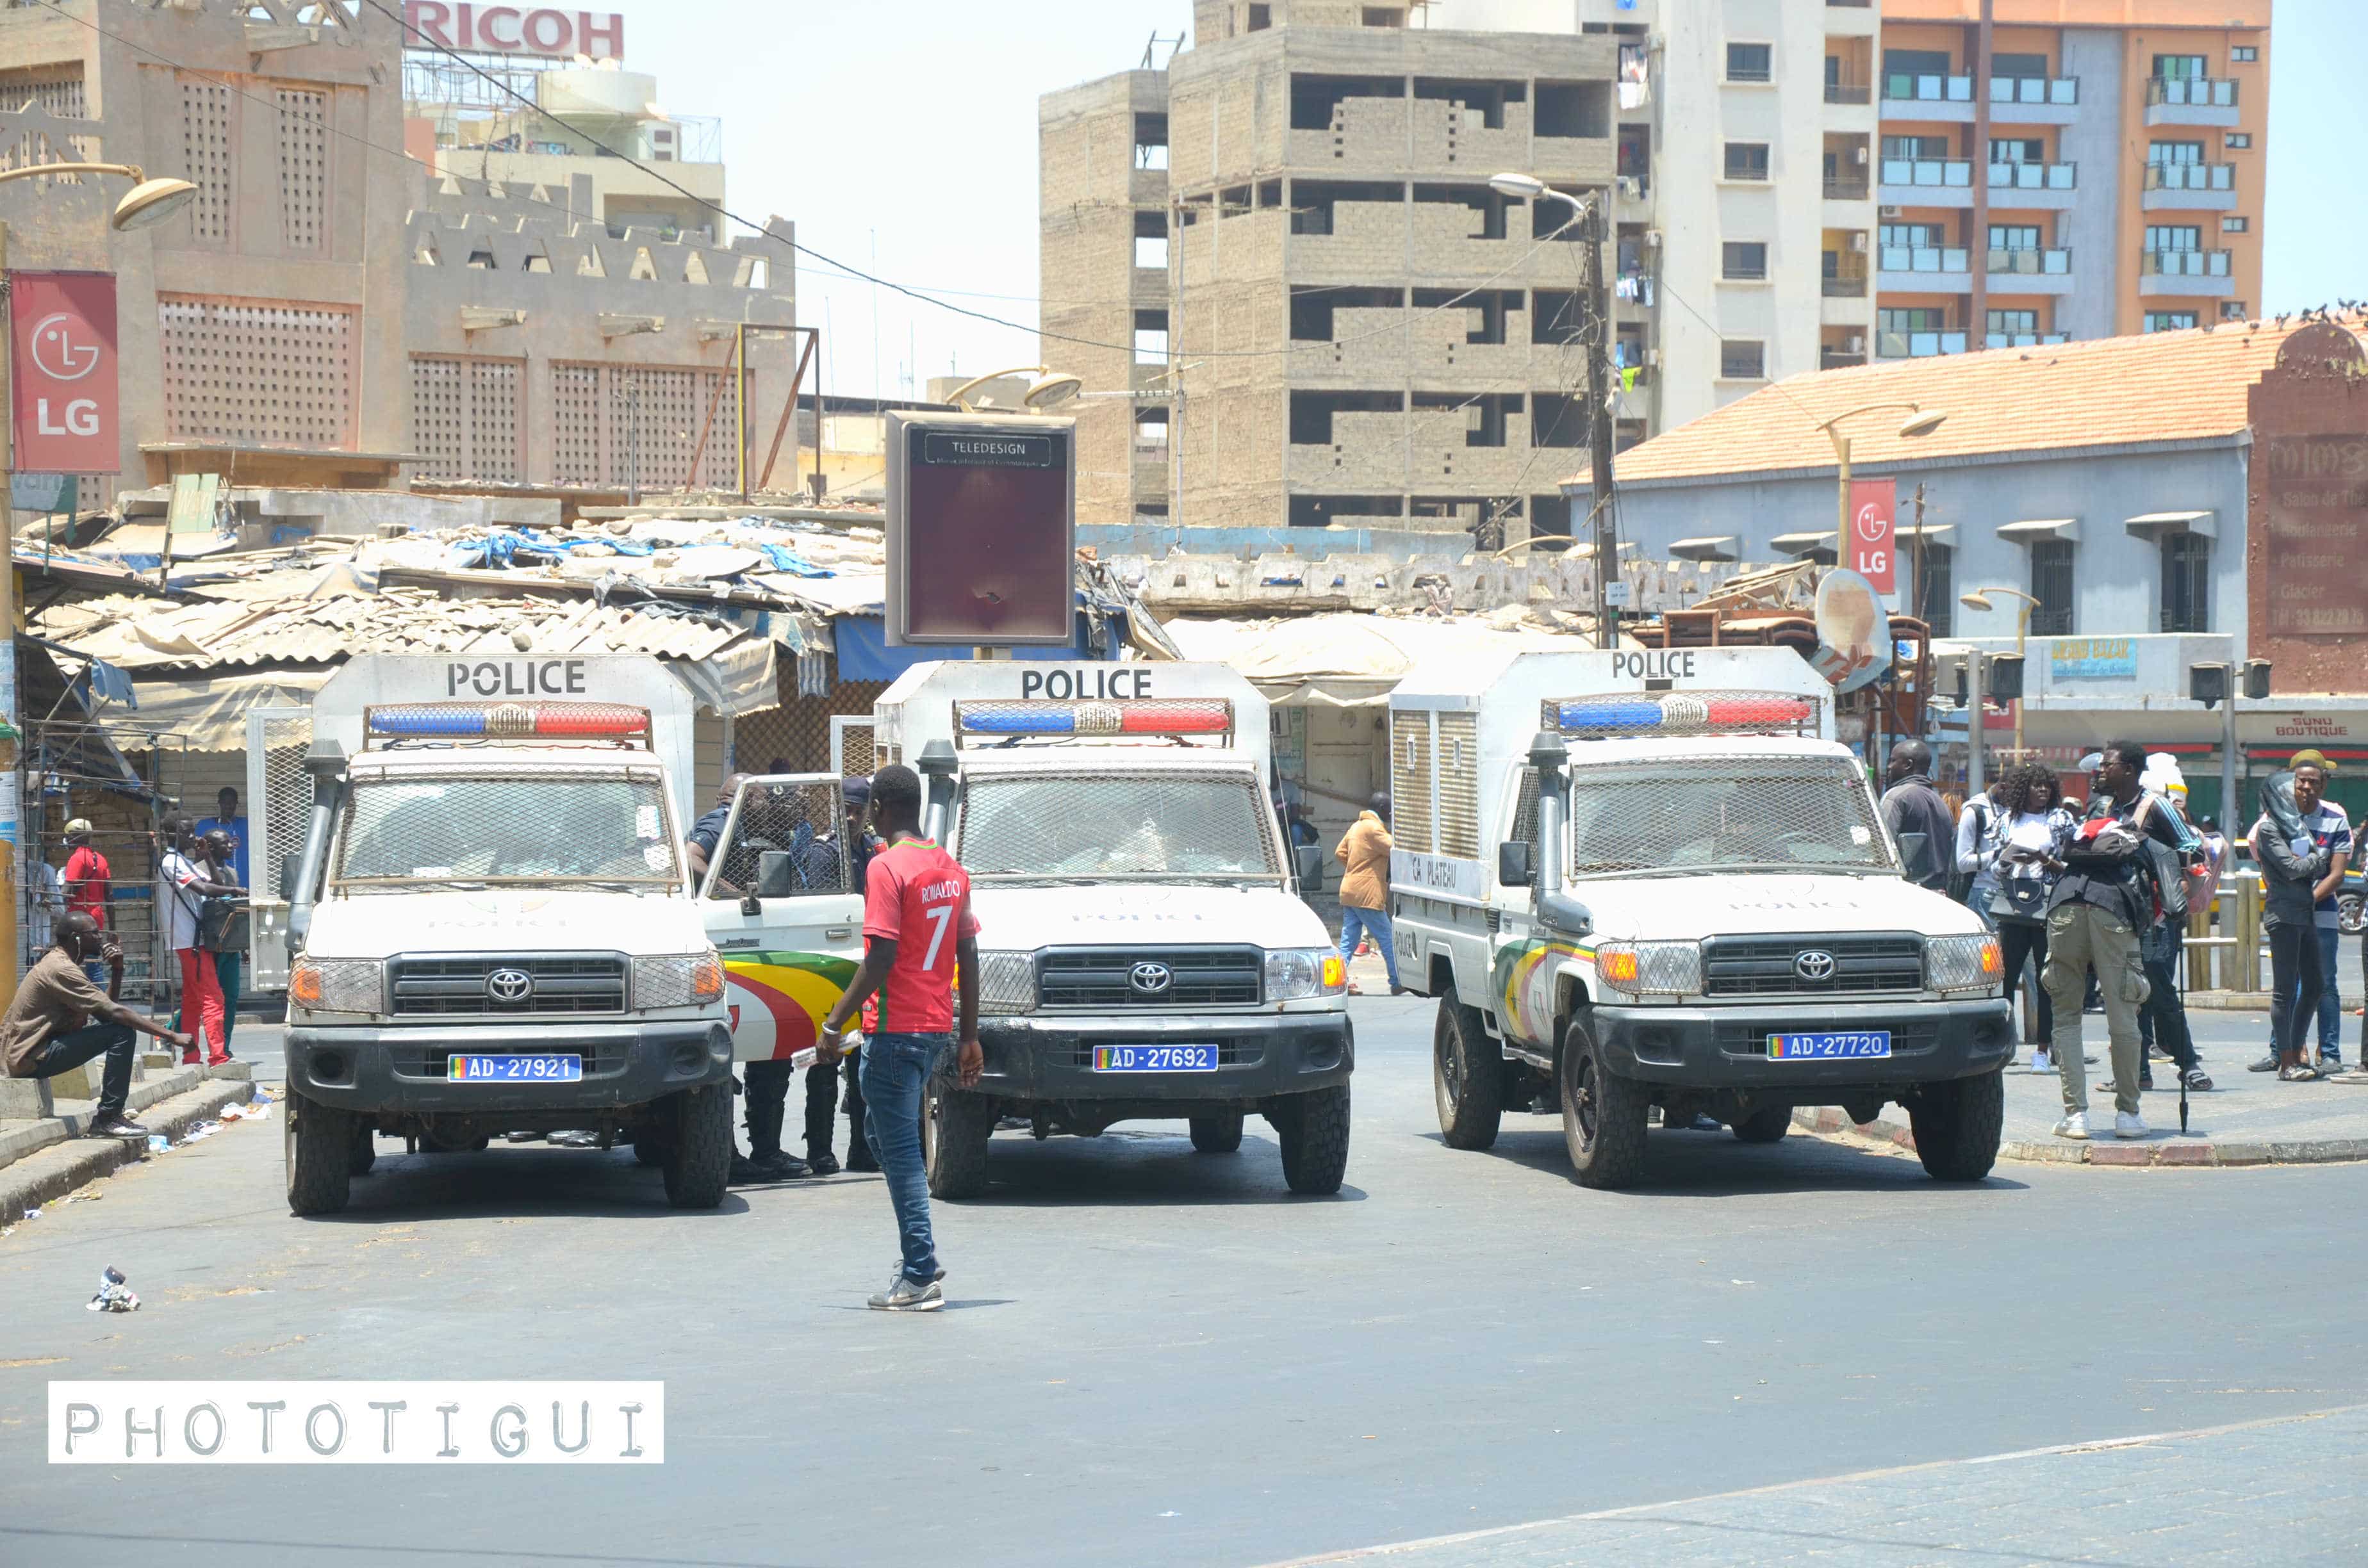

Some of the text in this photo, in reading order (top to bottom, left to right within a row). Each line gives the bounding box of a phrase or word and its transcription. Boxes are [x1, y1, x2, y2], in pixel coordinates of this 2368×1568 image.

[405, 1, 624, 58] RICOH
[38, 398, 99, 436] LG
[952, 442, 1025, 455] TELEDESIGN
[1859, 551, 1886, 573] LG
[447, 660, 586, 697] POLICE
[1612, 651, 1695, 679] POLICE
[1022, 669, 1153, 700] POLICE
[2275, 726, 2348, 737] BOUTIQUE
[2292, 717, 2333, 726] SUNU
[1412, 856, 1456, 889] CA PLATEAU
[921, 880, 960, 904] RONALDO
[923, 905, 953, 972] 7
